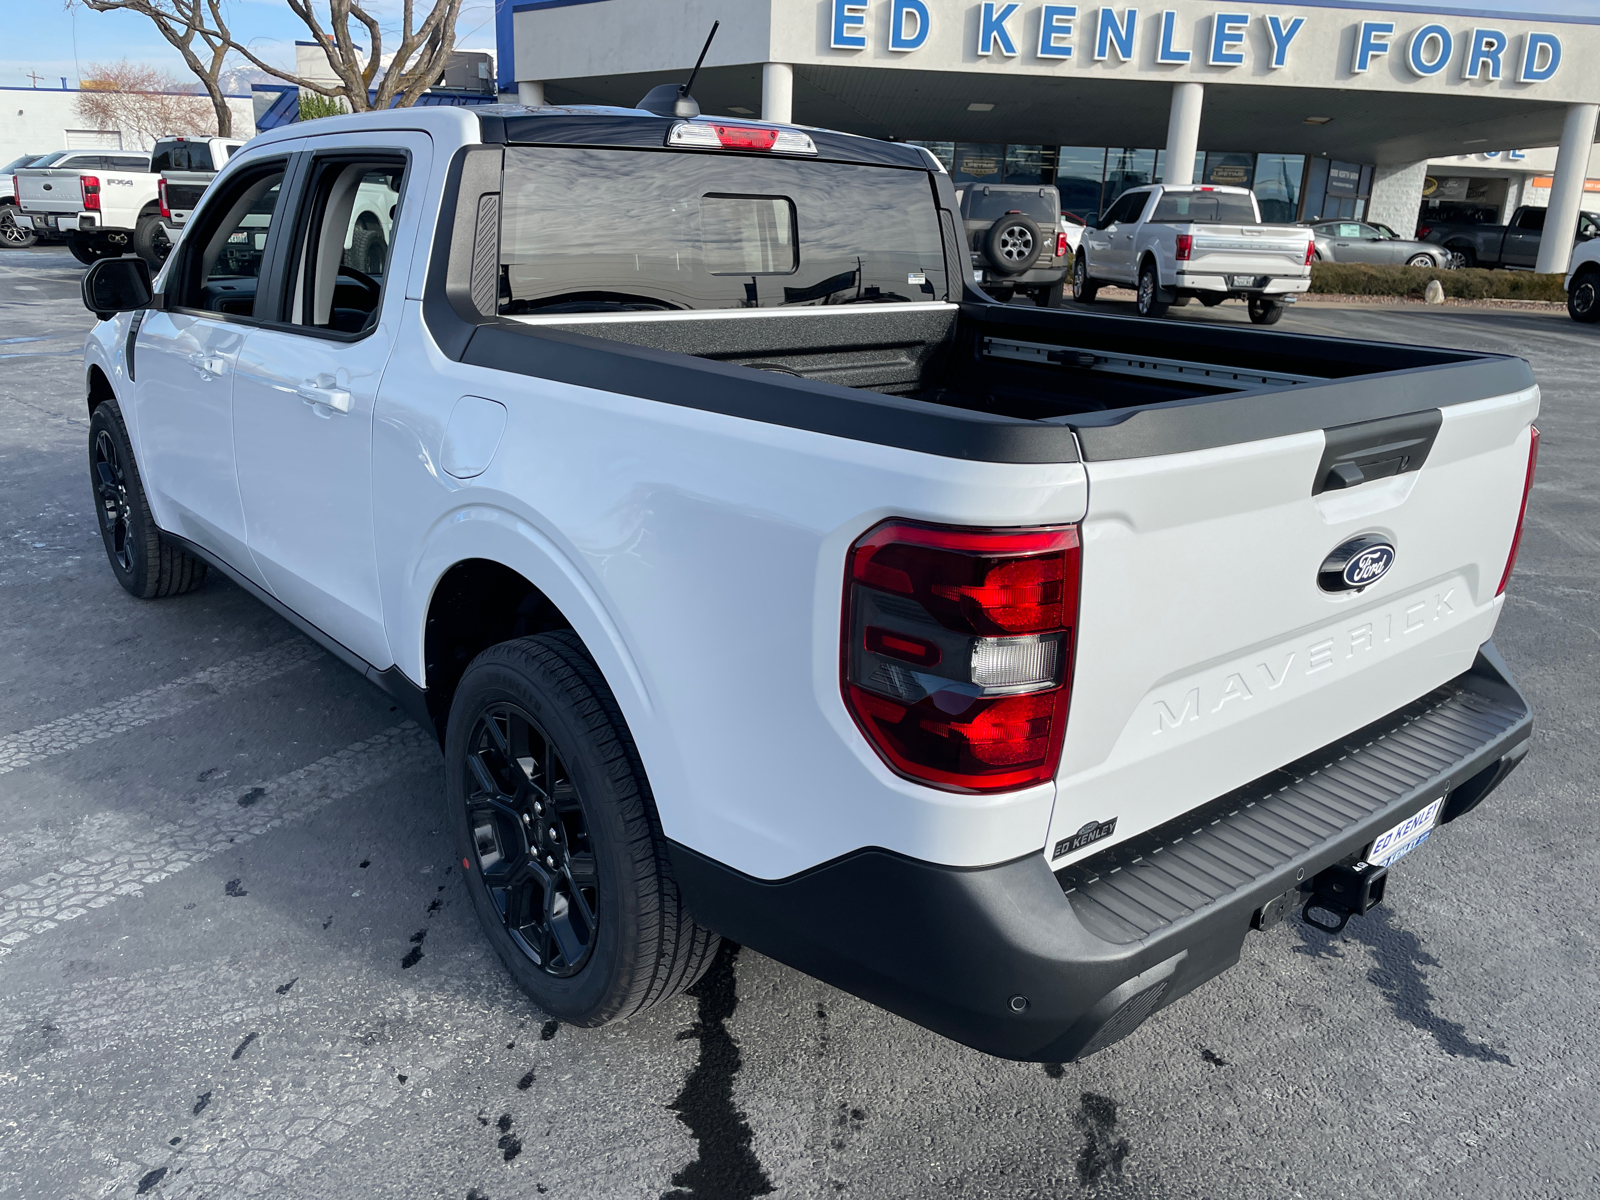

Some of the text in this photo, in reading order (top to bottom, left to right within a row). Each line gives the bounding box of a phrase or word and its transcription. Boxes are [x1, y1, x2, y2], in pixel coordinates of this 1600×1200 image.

[830, 0, 1563, 83] ED KENLEY FORD
[107, 178, 133, 186] FX4
[1353, 551, 1387, 581] Ford
[1152, 588, 1455, 735] MAVERICK
[1055, 842, 1070, 857] ED
[1073, 821, 1117, 849] KENLEY
[1373, 832, 1394, 855] ED
